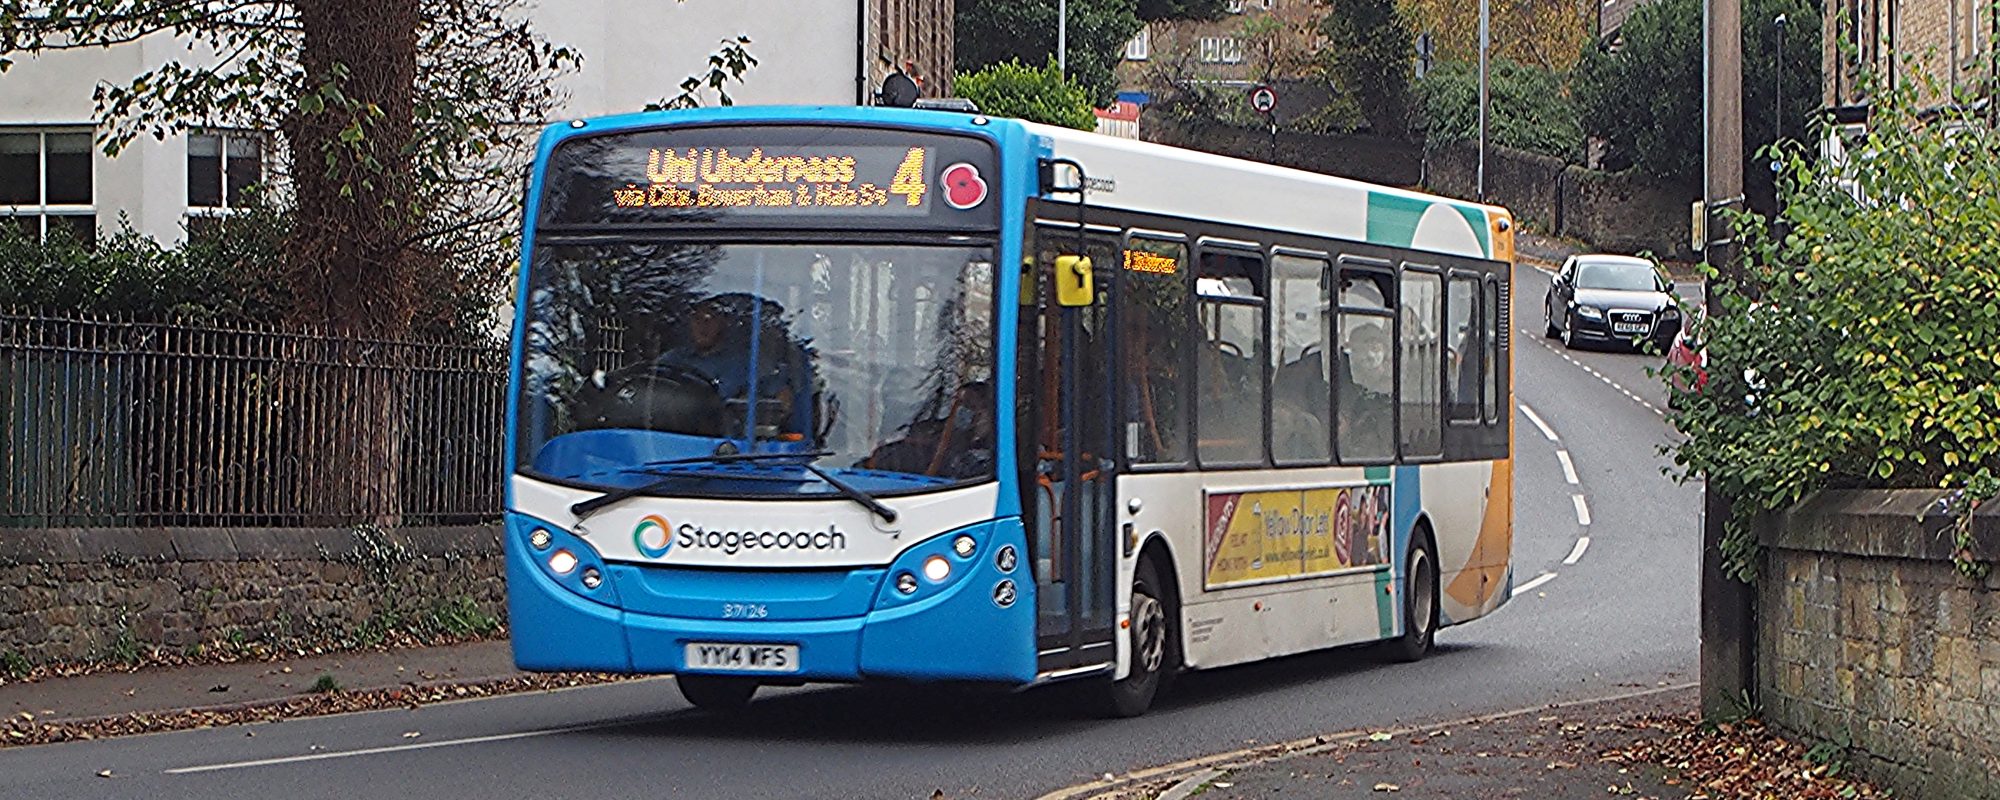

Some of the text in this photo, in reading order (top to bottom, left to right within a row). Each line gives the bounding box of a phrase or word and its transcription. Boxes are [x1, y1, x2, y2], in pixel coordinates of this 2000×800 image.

[647, 148, 856, 183] Uni Underpass
[889, 146, 927, 206] 4
[613, 183, 646, 207] via
[815, 183, 858, 207] Hala
[678, 523, 845, 556] Stagecoach
[722, 604, 768, 619] 37126
[700, 646, 742, 666] YY14
